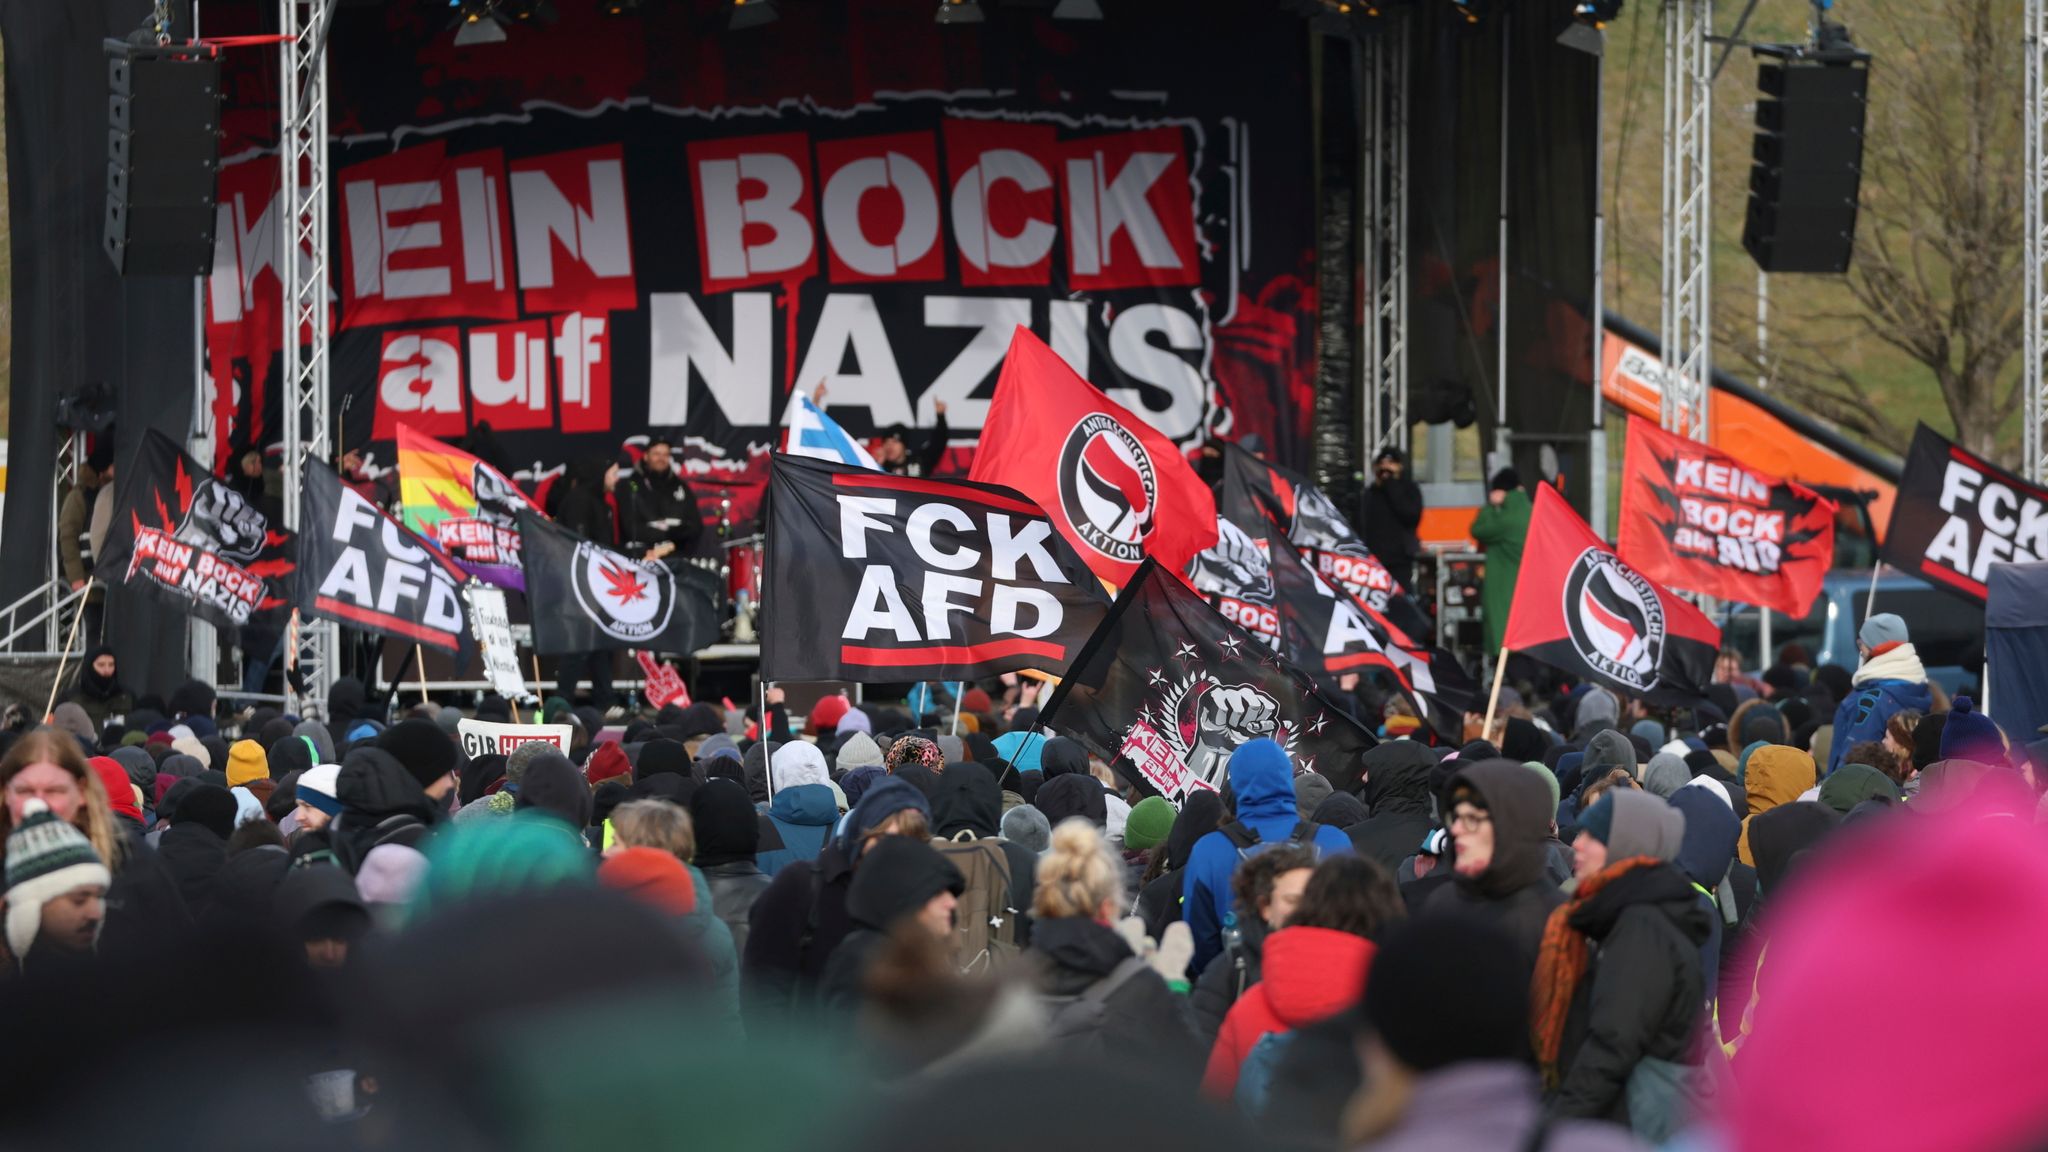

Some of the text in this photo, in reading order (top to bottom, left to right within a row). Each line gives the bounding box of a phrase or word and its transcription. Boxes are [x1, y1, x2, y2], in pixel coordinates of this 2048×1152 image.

[211, 148, 1184, 324] KEIN BOCK
[380, 291, 1202, 433] auf NAZIS
[1081, 416, 1154, 507] ANTIFASCHISTISCH
[1675, 458, 1769, 500] KEIN
[441, 522, 495, 545] KEIN
[836, 494, 1072, 584] FCK
[1078, 522, 1140, 560] AKTION
[1680, 498, 1784, 542] BOCK
[1939, 460, 2048, 560] FCK
[139, 532, 259, 606] KEIN BOCK
[153, 559, 252, 625] auf NAZIS
[318, 545, 464, 635] AFD
[1318, 553, 1388, 591] BOCK
[841, 564, 1065, 642] AFD
[1220, 601, 1281, 636] BOC
[463, 731, 497, 757] GIB
[1131, 722, 1188, 787] KEIN
